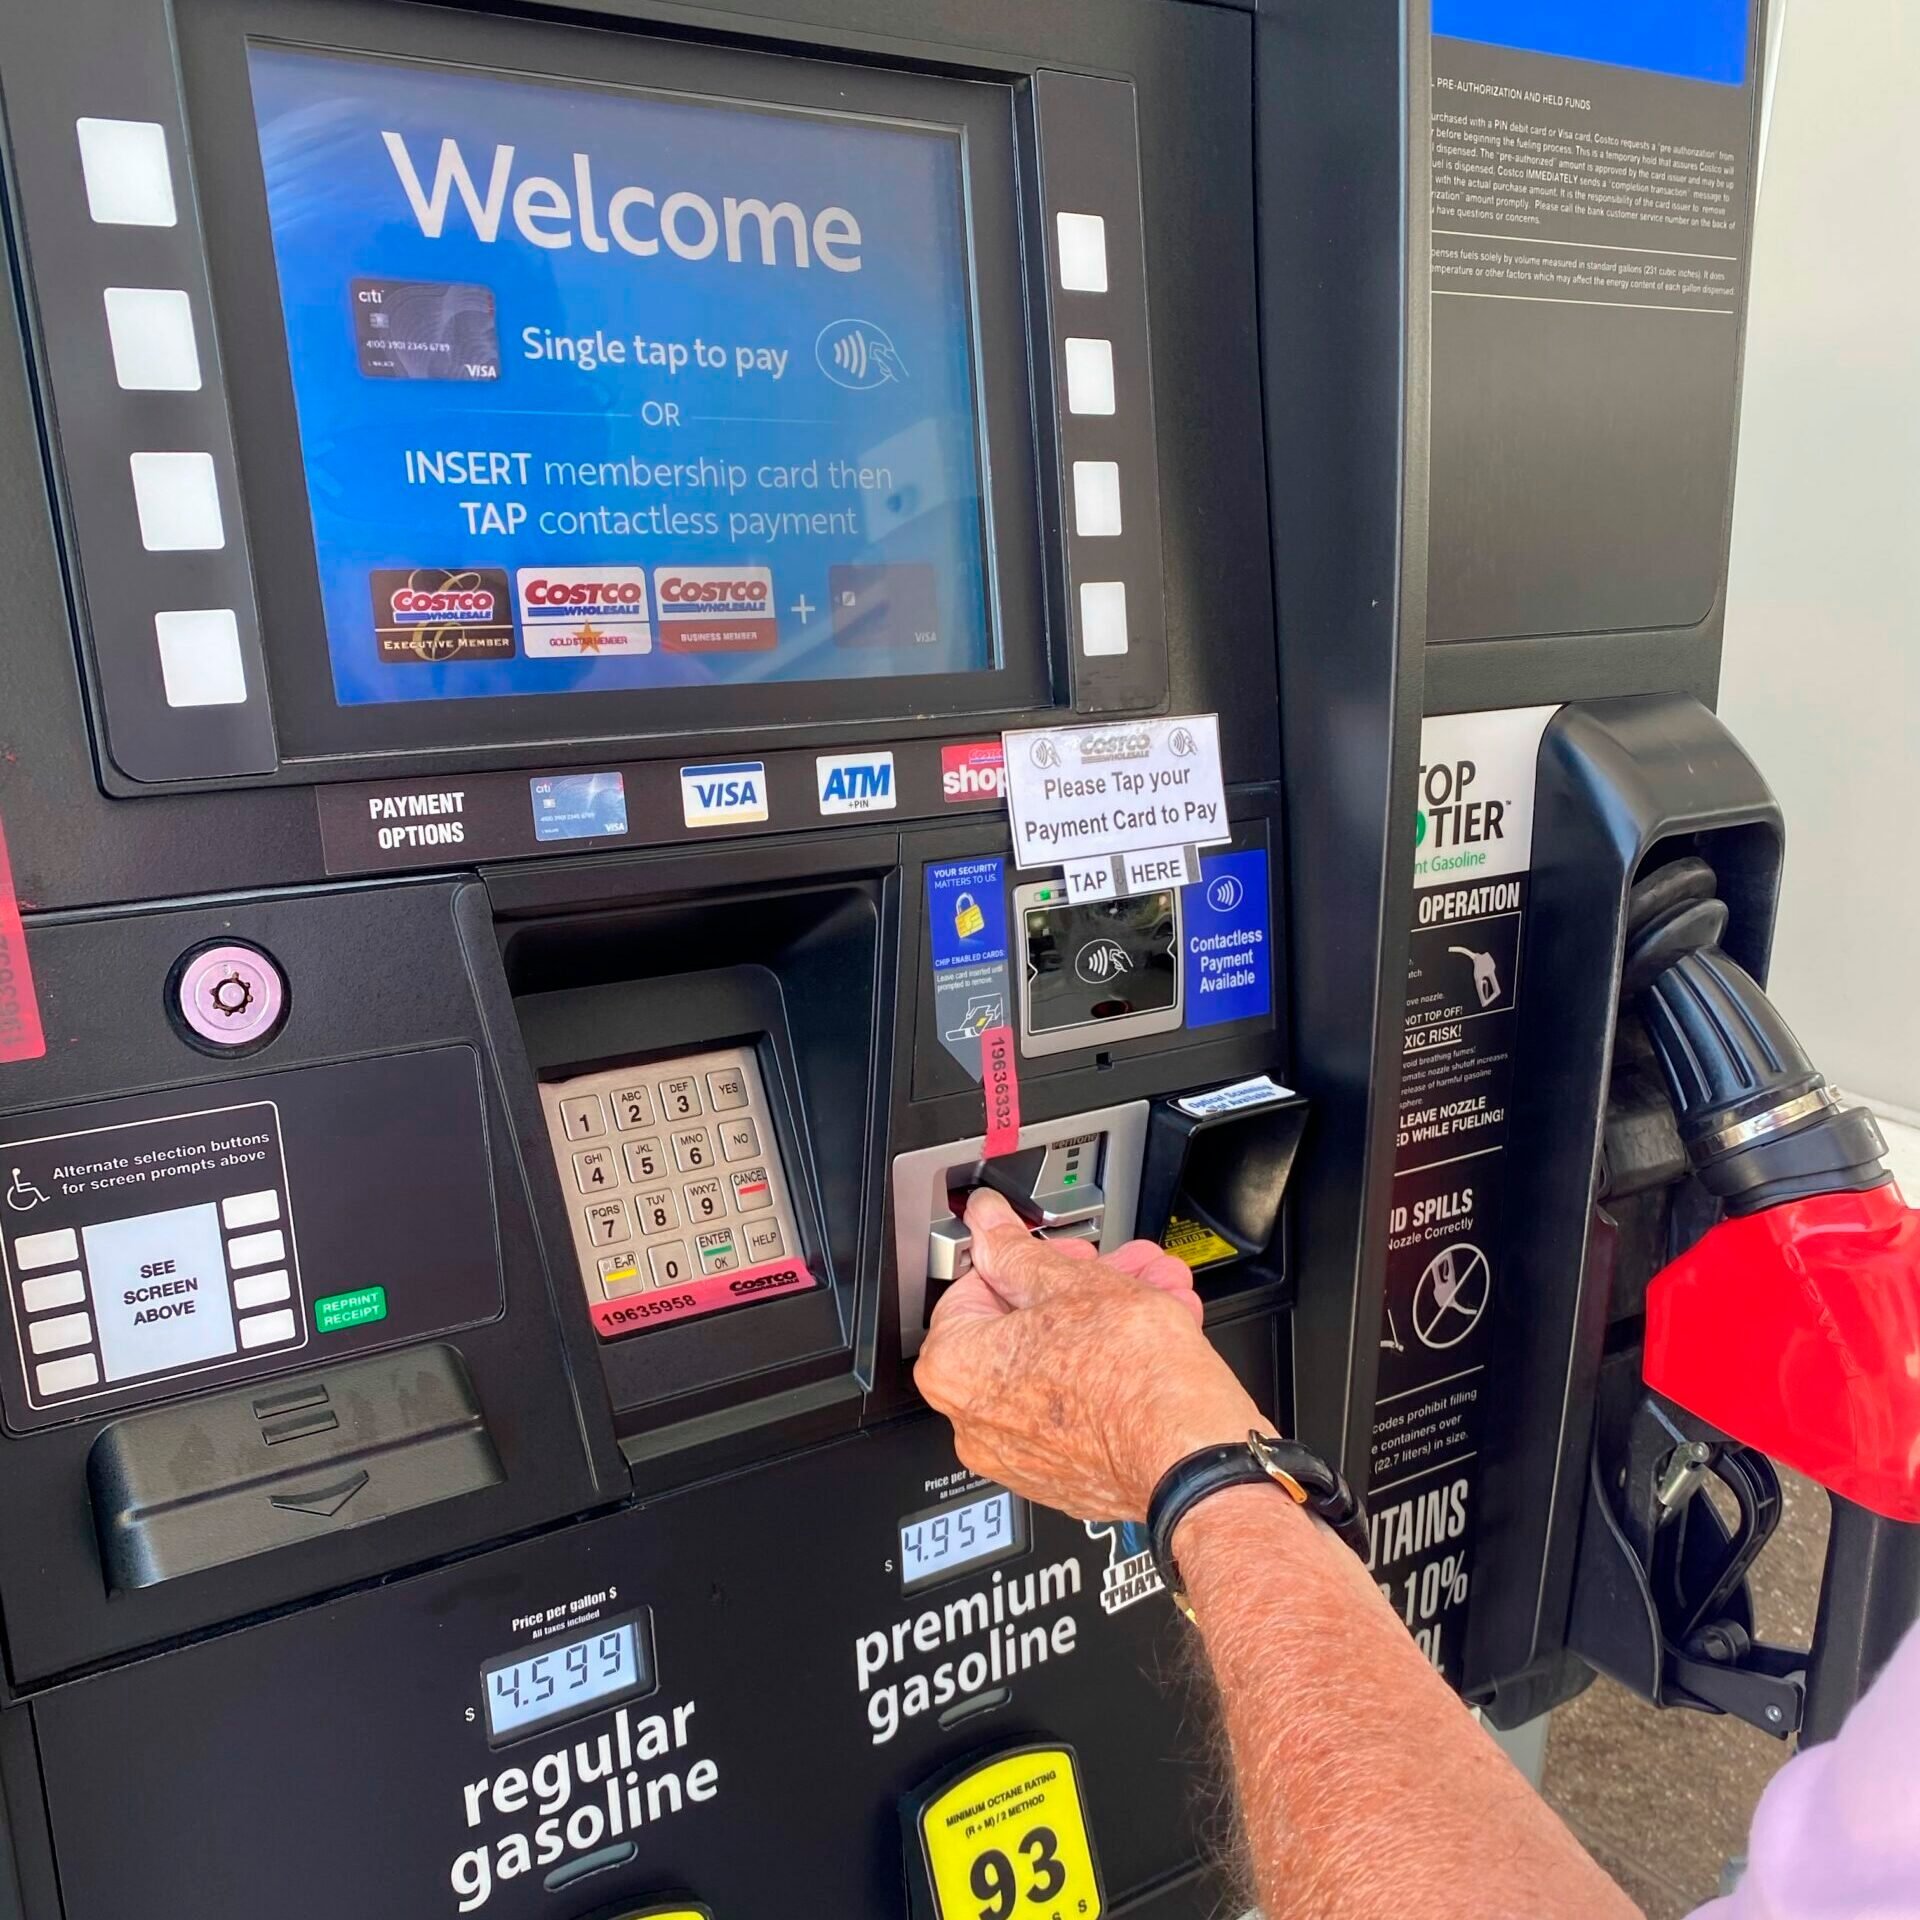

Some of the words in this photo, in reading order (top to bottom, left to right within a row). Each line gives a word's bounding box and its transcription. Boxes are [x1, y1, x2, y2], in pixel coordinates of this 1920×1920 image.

[1437, 77, 1522, 100] PRE-AUTHORIZATION
[1524, 91, 1540, 102] AND
[1543, 94, 1563, 106] HELD
[1565, 97, 1591, 110] FUNDS
[1463, 130, 1500, 147] beginning
[1594, 133, 1619, 146] Costco
[1480, 147, 1495, 160] The
[1497, 165, 1524, 178] Costco
[1526, 168, 1579, 184] IMMEDIATELY
[1493, 182, 1527, 195] purchase
[381, 131, 862, 272] Welcome
[1535, 199, 1559, 212] Please
[1457, 208, 1494, 220] questions
[1542, 257, 1577, 269] measured
[1506, 269, 1532, 280] factors
[358, 289, 383, 304] citi
[521, 326, 626, 371] Single
[632, 335, 688, 374] tap
[693, 338, 727, 368] to
[735, 346, 789, 380] pay
[464, 364, 496, 378] VISA
[641, 400, 681, 427] OR
[404, 450, 532, 485] INSERT
[544, 455, 747, 497] membership
[757, 459, 818, 489] card
[828, 460, 893, 489] then
[459, 502, 528, 535] TAP
[539, 504, 719, 535] contactless
[729, 508, 859, 543] payment
[525, 580, 641, 604] COSTCO
[660, 577, 768, 602] COSTCO
[392, 590, 494, 612] COSTCO
[564, 604, 639, 616] WHOLESALE
[697, 601, 766, 613] WHOLESALE
[425, 610, 492, 621] WHOLESALE
[457, 637, 509, 649] MEMBER
[680, 631, 722, 642] BUSINESS
[723, 631, 758, 642] MEMBER
[914, 632, 937, 643] VISA
[1079, 733, 1151, 756] COSTCO
[1103, 751, 1149, 763] WHOLESALE
[822, 764, 891, 801] ATM
[1045, 777, 1106, 800] Please
[1112, 771, 1144, 795] Tap
[1150, 768, 1190, 792] your
[692, 781, 758, 808] VISA
[368, 792, 465, 820] PAYMENT
[604, 822, 625, 833] VISA
[1025, 813, 1109, 844] Payment
[1113, 807, 1157, 830] Card
[1162, 805, 1179, 823] to
[1184, 801, 1217, 825] Pay
[1429, 800, 1504, 848] TIER
[377, 821, 465, 849] OPTIONS
[934, 867, 957, 879] YOUR
[958, 863, 997, 876] SECURITY
[1431, 851, 1487, 872] Gasoline
[934, 877, 972, 889] MATTERS
[1070, 870, 1107, 892] TAP
[1130, 860, 1182, 885] HERE
[1418, 882, 1521, 924] OPERATION
[1190, 929, 1262, 954] Contactless
[951, 952, 981, 965] ENABLED
[1200, 951, 1254, 974] Payment
[1200, 970, 1256, 994] Available
[1424, 1010, 1441, 1022] TOP
[1443, 1005, 1463, 1018] OFF!
[1404, 1032, 1425, 1049] XIC
[1429, 1023, 1462, 1044] RISK!
[1419, 1051, 1452, 1064] breathing
[991, 1036, 1011, 1130] 19636332
[1463, 1068, 1492, 1082] gasoline
[621, 1090, 641, 1102] ABC
[669, 1081, 689, 1093] DEF
[718, 1082, 739, 1095] YES
[629, 1105, 642, 1123] 2
[677, 1096, 690, 1113] 3
[1400, 1107, 1437, 1129] LEAVE
[1439, 1096, 1486, 1119] NOZZLE
[579, 1113, 590, 1132] 1
[1411, 1121, 1449, 1143] WHILE
[1451, 1107, 1505, 1133] FUELING!
[636, 1144, 652, 1154] JKL
[680, 1133, 703, 1145] MNO
[733, 1132, 749, 1145] NO
[52, 1157, 129, 1180] Alternate
[133, 1144, 207, 1166] selection
[210, 1133, 270, 1152] buttons
[584, 1153, 603, 1165] GHI
[641, 1157, 654, 1175] 5
[689, 1147, 702, 1165] 6
[62, 1181, 86, 1195] for
[90, 1172, 146, 1190] screen
[150, 1158, 216, 1182] prompts
[220, 1150, 266, 1167] above
[591, 1167, 604, 1185] 4
[733, 1170, 767, 1186] CANCEL
[689, 1182, 718, 1196] WXYZ
[646, 1194, 665, 1206] TUV
[701, 1197, 714, 1215] 9
[1412, 1188, 1473, 1228] SPILLS
[591, 1205, 620, 1219] PQRS
[654, 1208, 667, 1226] 8
[603, 1220, 615, 1238] 7
[752, 1231, 777, 1246] HELP
[1424, 1216, 1474, 1240] Correctly
[699, 1231, 731, 1248] ENTER
[1165, 1231, 1207, 1248] CAUTION
[139, 1259, 176, 1279] SEE
[714, 1257, 729, 1269] OK
[122, 1277, 198, 1305] SCREEN
[729, 1270, 797, 1292] COSTCO
[133, 1300, 196, 1326] ABOVE
[321, 1292, 378, 1314] REPRINT
[601, 1294, 697, 1327] 19635958
[323, 1305, 380, 1326] RECEIPT
[1372, 1415, 1405, 1435] codes
[1407, 1398, 1447, 1424] prohibit
[1449, 1389, 1478, 1406] filling
[1380, 1423, 1437, 1452] containers
[1438, 1414, 1463, 1430] over
[1374, 1453, 1400, 1475] (22.7
[1402, 1441, 1431, 1462] liters)
[1433, 1439, 1444, 1451] in
[1445, 1431, 1469, 1446] size.
[925, 1475, 949, 1492] Price
[951, 1470, 966, 1484] per
[904, 1498, 1001, 1563] 4.959
[1404, 1549, 1468, 1626] 10%
[511, 1612, 543, 1632] Price
[546, 1604, 567, 1621] per
[569, 1591, 606, 1613] gallon
[533, 1628, 543, 1639] All
[544, 1622, 566, 1636] taxes
[567, 1609, 600, 1628] included
[855, 1556, 1081, 1692] premium
[496, 1631, 621, 1708] 4.599
[867, 1615, 1077, 1745] gasoline
[465, 1707, 475, 1722] $
[463, 1700, 695, 1828] regular
[946, 1803, 986, 1827] MINIMUM
[987, 1785, 1023, 1808] OCTANE
[1024, 1770, 1057, 1791] RATING
[1008, 1793, 1045, 1817] METHOD
[450, 1758, 719, 1913] gasoline
[970, 1826, 1066, 1920] 93
